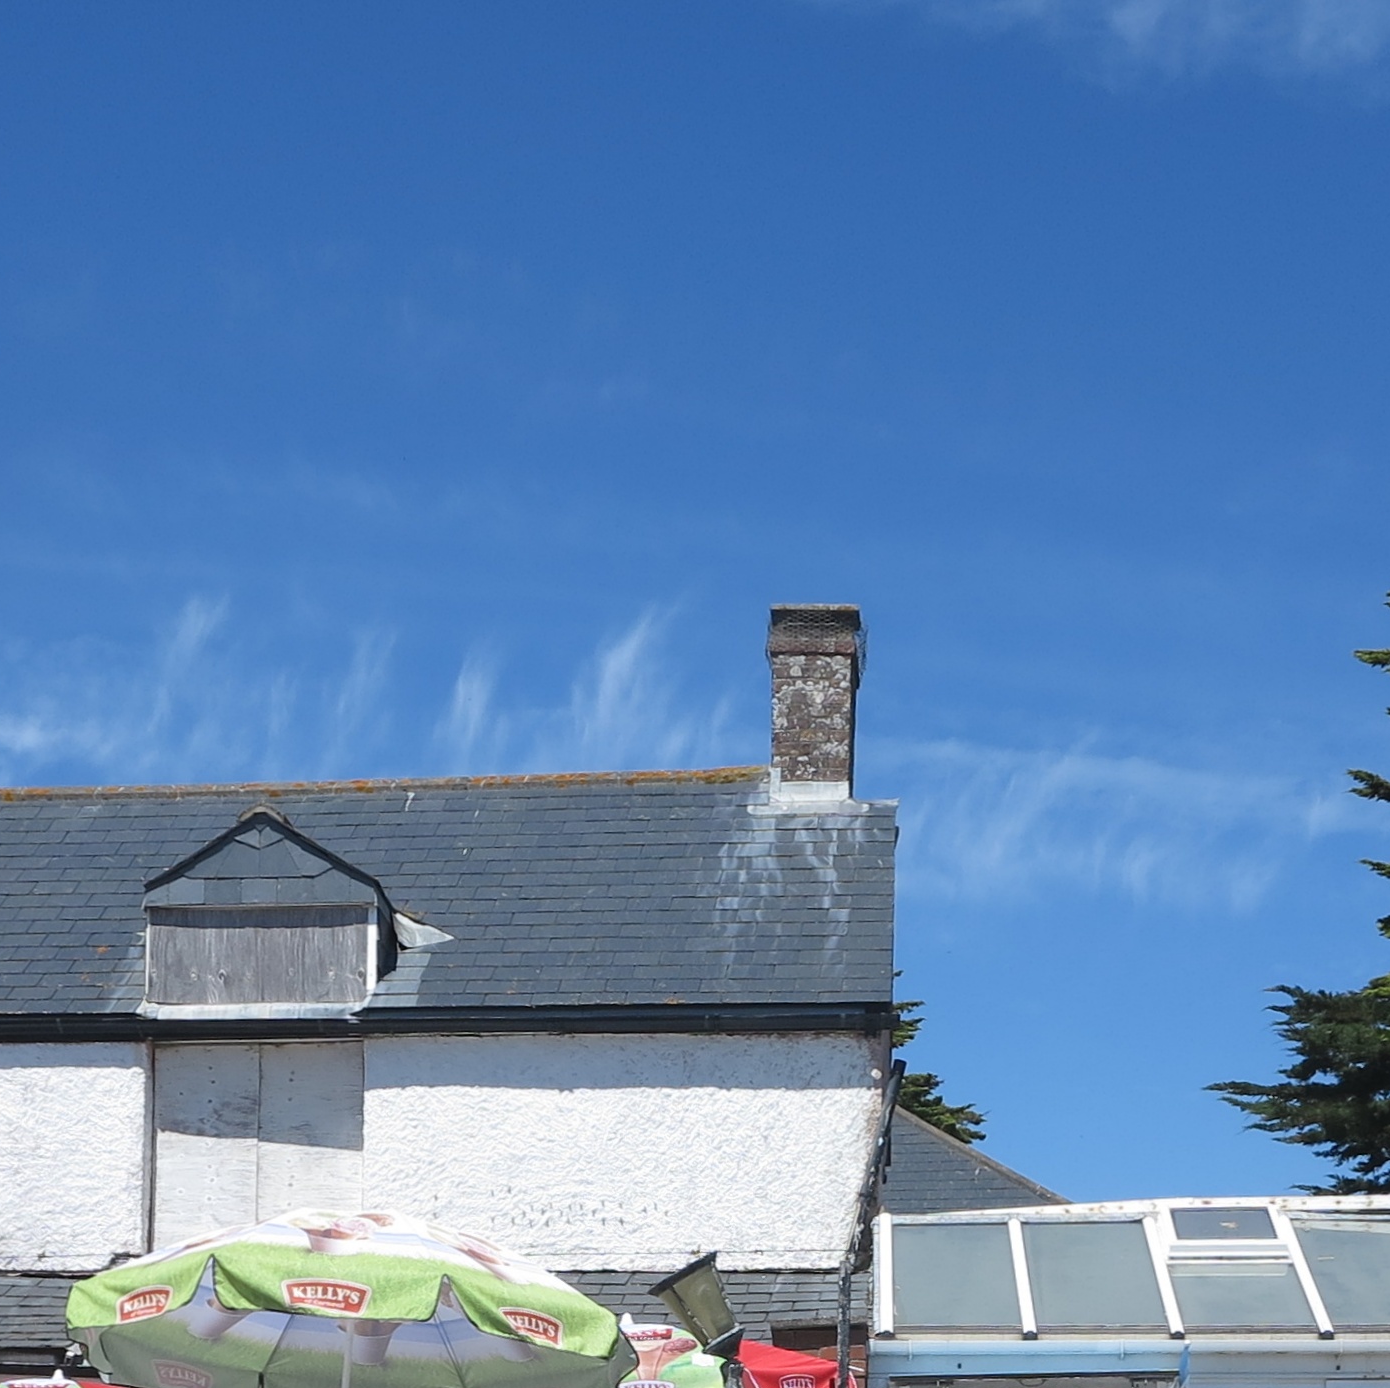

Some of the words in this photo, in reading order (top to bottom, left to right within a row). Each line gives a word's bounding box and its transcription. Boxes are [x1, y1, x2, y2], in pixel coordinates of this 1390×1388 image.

[122, 1293, 166, 1314] KELLY'S
[291, 1286, 361, 1304] KELLY'S
[507, 1315, 556, 1338] KELLY'S
